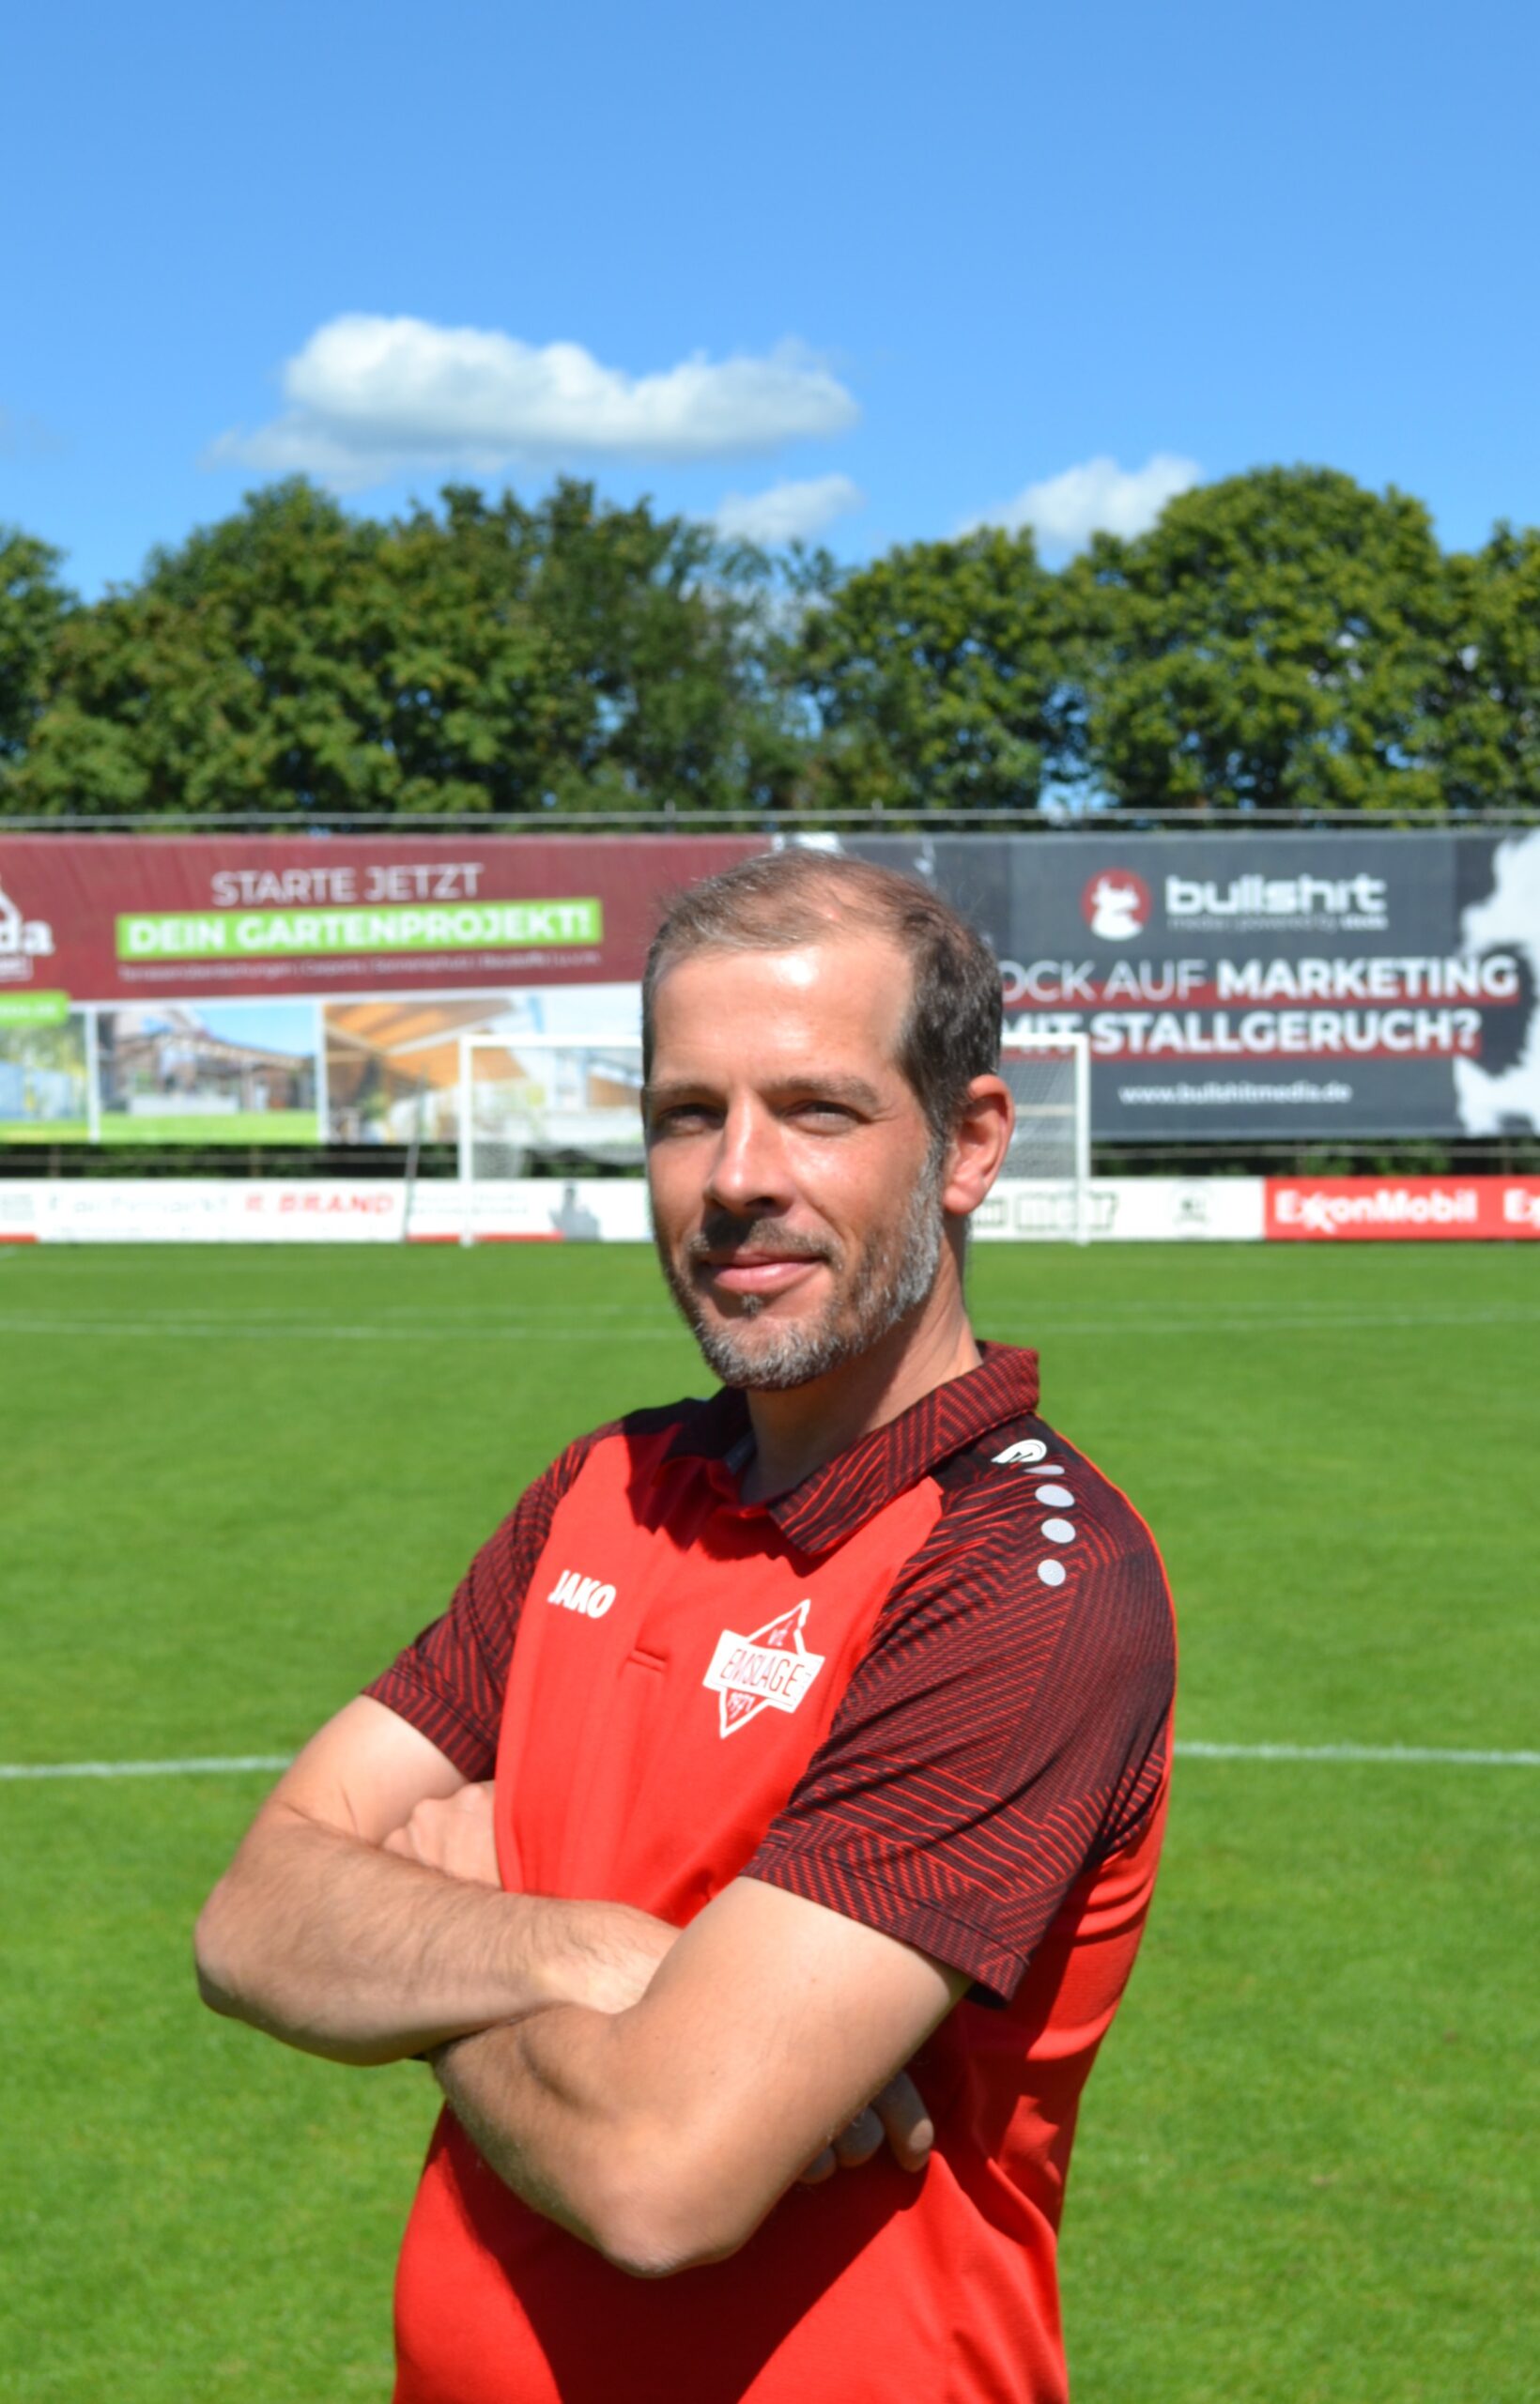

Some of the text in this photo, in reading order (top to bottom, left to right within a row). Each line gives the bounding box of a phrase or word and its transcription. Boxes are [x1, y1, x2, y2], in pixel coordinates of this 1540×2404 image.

[210, 863, 485, 907] STARTE JETZT
[1165, 873, 1388, 915] bullshit
[129, 902, 593, 954] DEIN GARTENPROJEKT!
[999, 954, 1519, 1003] OCK AUF MARKETING
[1089, 1008, 1484, 1055] STALLGERUCH?
[547, 1568, 617, 1619] JAKO
